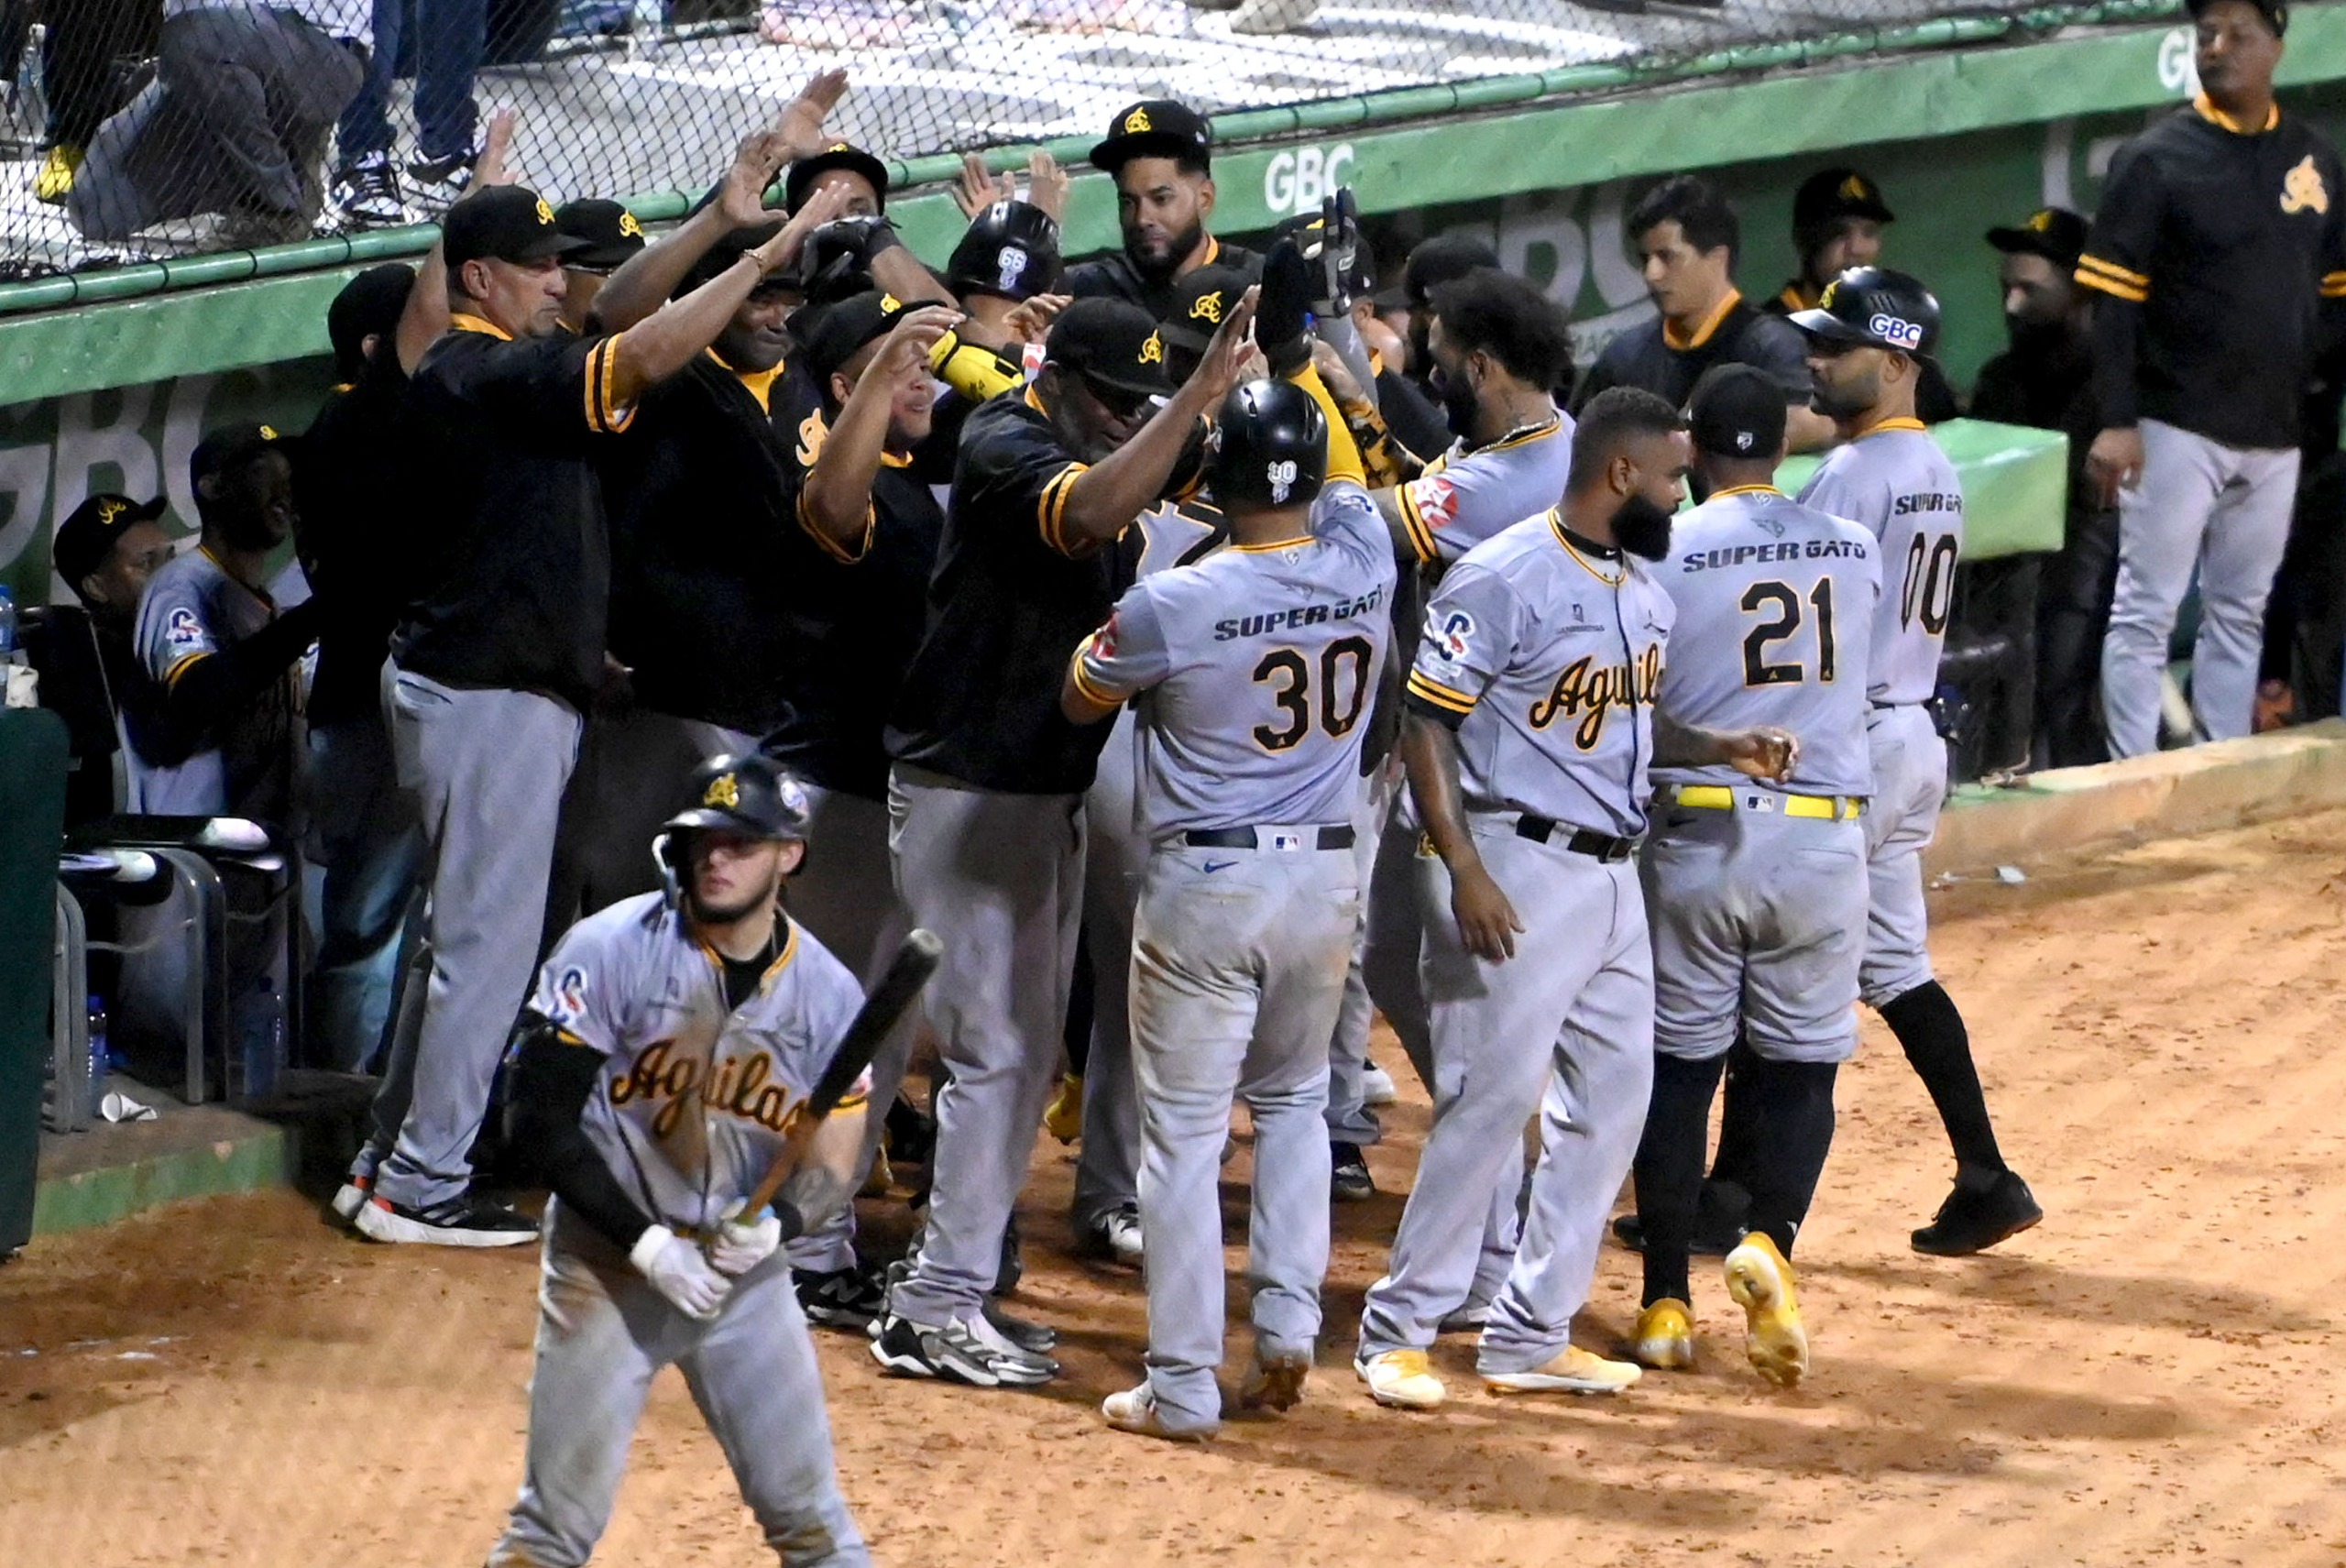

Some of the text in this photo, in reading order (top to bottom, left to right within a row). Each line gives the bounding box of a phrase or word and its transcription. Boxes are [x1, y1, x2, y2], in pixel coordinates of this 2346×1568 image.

[1266, 142, 1354, 213] GBC
[998, 246, 1027, 273] 66
[1869, 313, 1922, 344] GBC
[1267, 460, 1298, 484] 30
[1683, 540, 1867, 573] SUPER GATO
[1214, 604, 1329, 641] SUPER
[1740, 576, 1835, 685] 21
[1253, 635, 1373, 751] 30
[1529, 641, 1666, 751] Aguil
